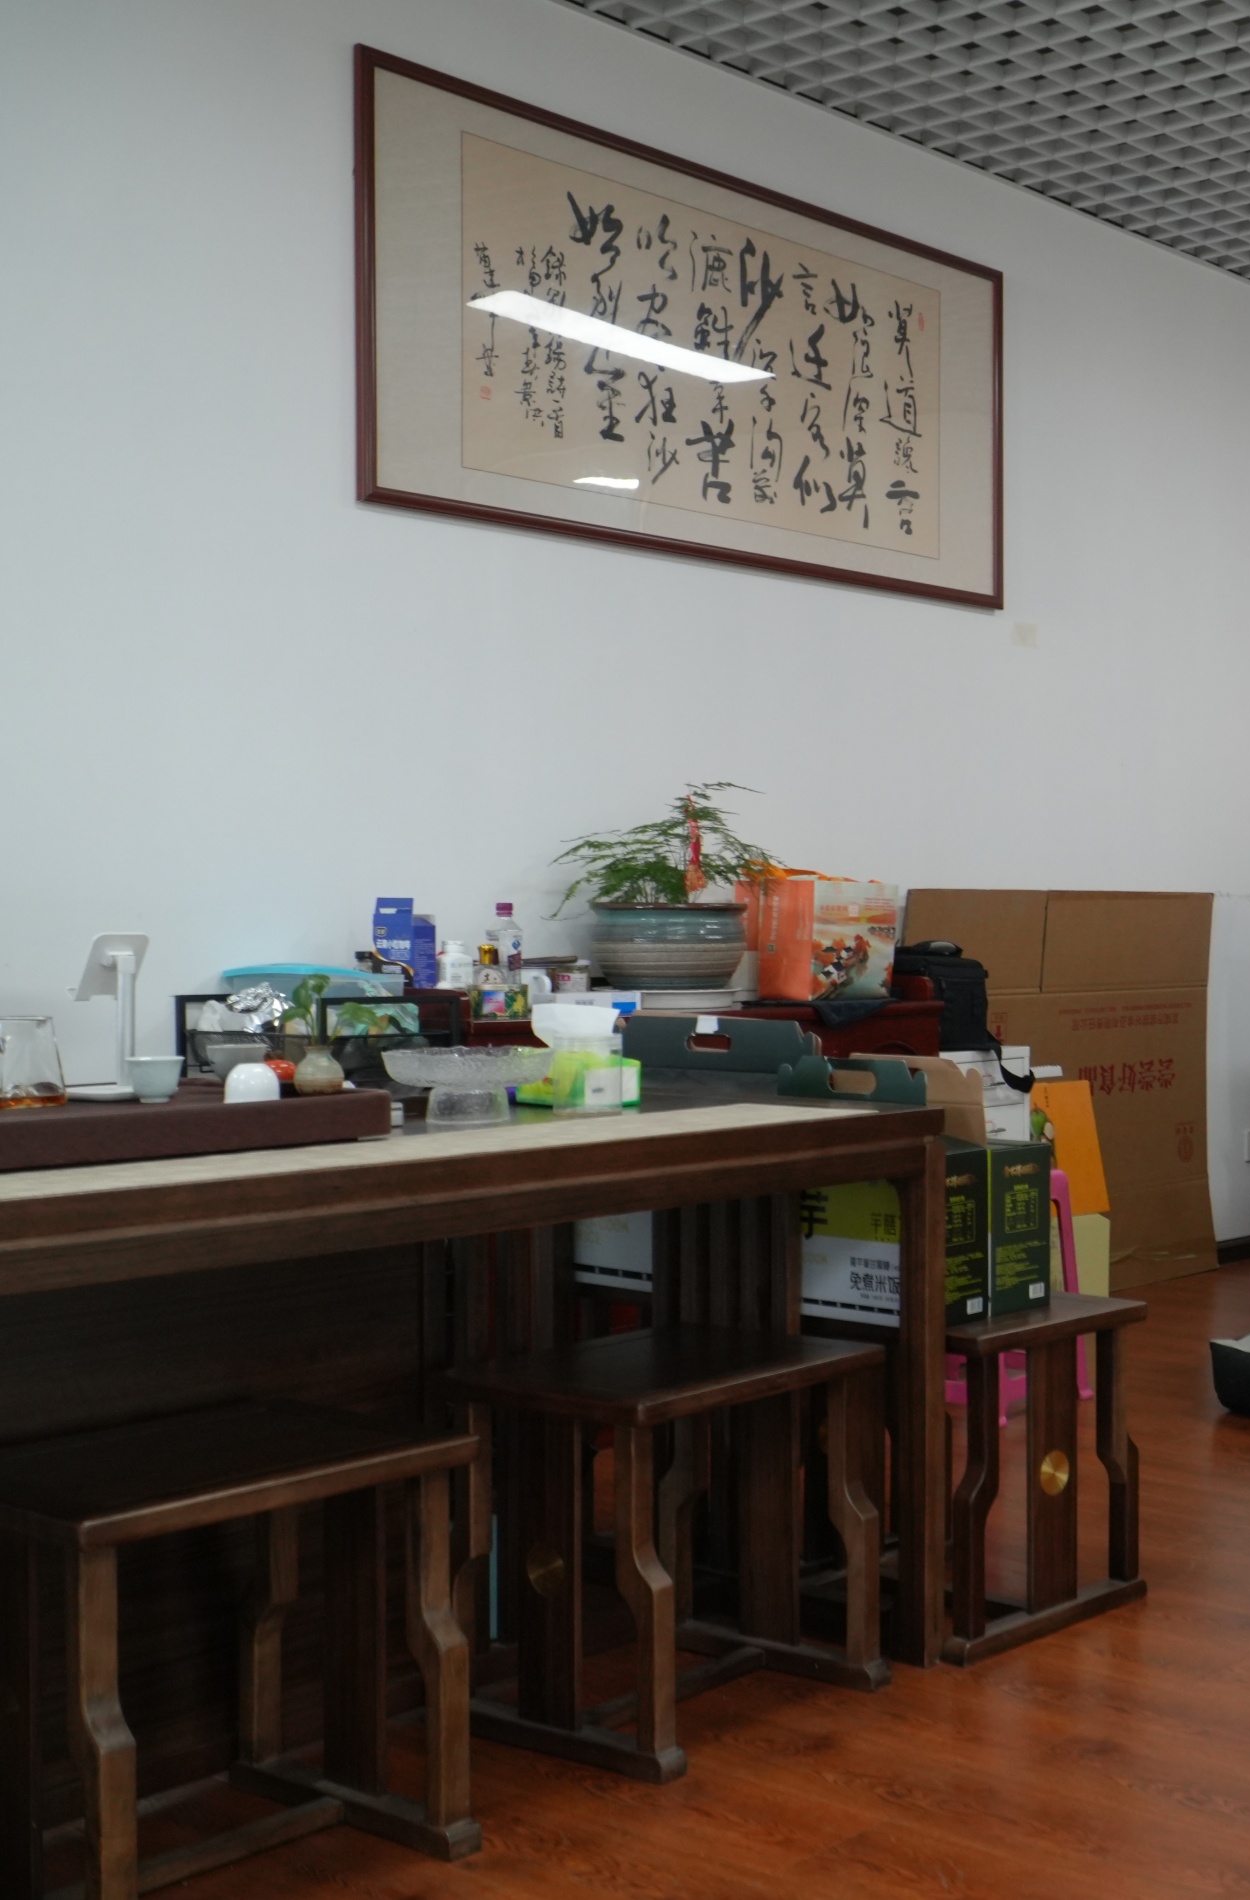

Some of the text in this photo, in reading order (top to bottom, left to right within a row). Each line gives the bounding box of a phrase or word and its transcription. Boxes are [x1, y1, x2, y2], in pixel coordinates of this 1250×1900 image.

[1078, 1058, 1176, 1097] 尝尝好食品
[871, 1212, 899, 1236] 芋膳
[849, 1271, 900, 1295] 免煮米饭
